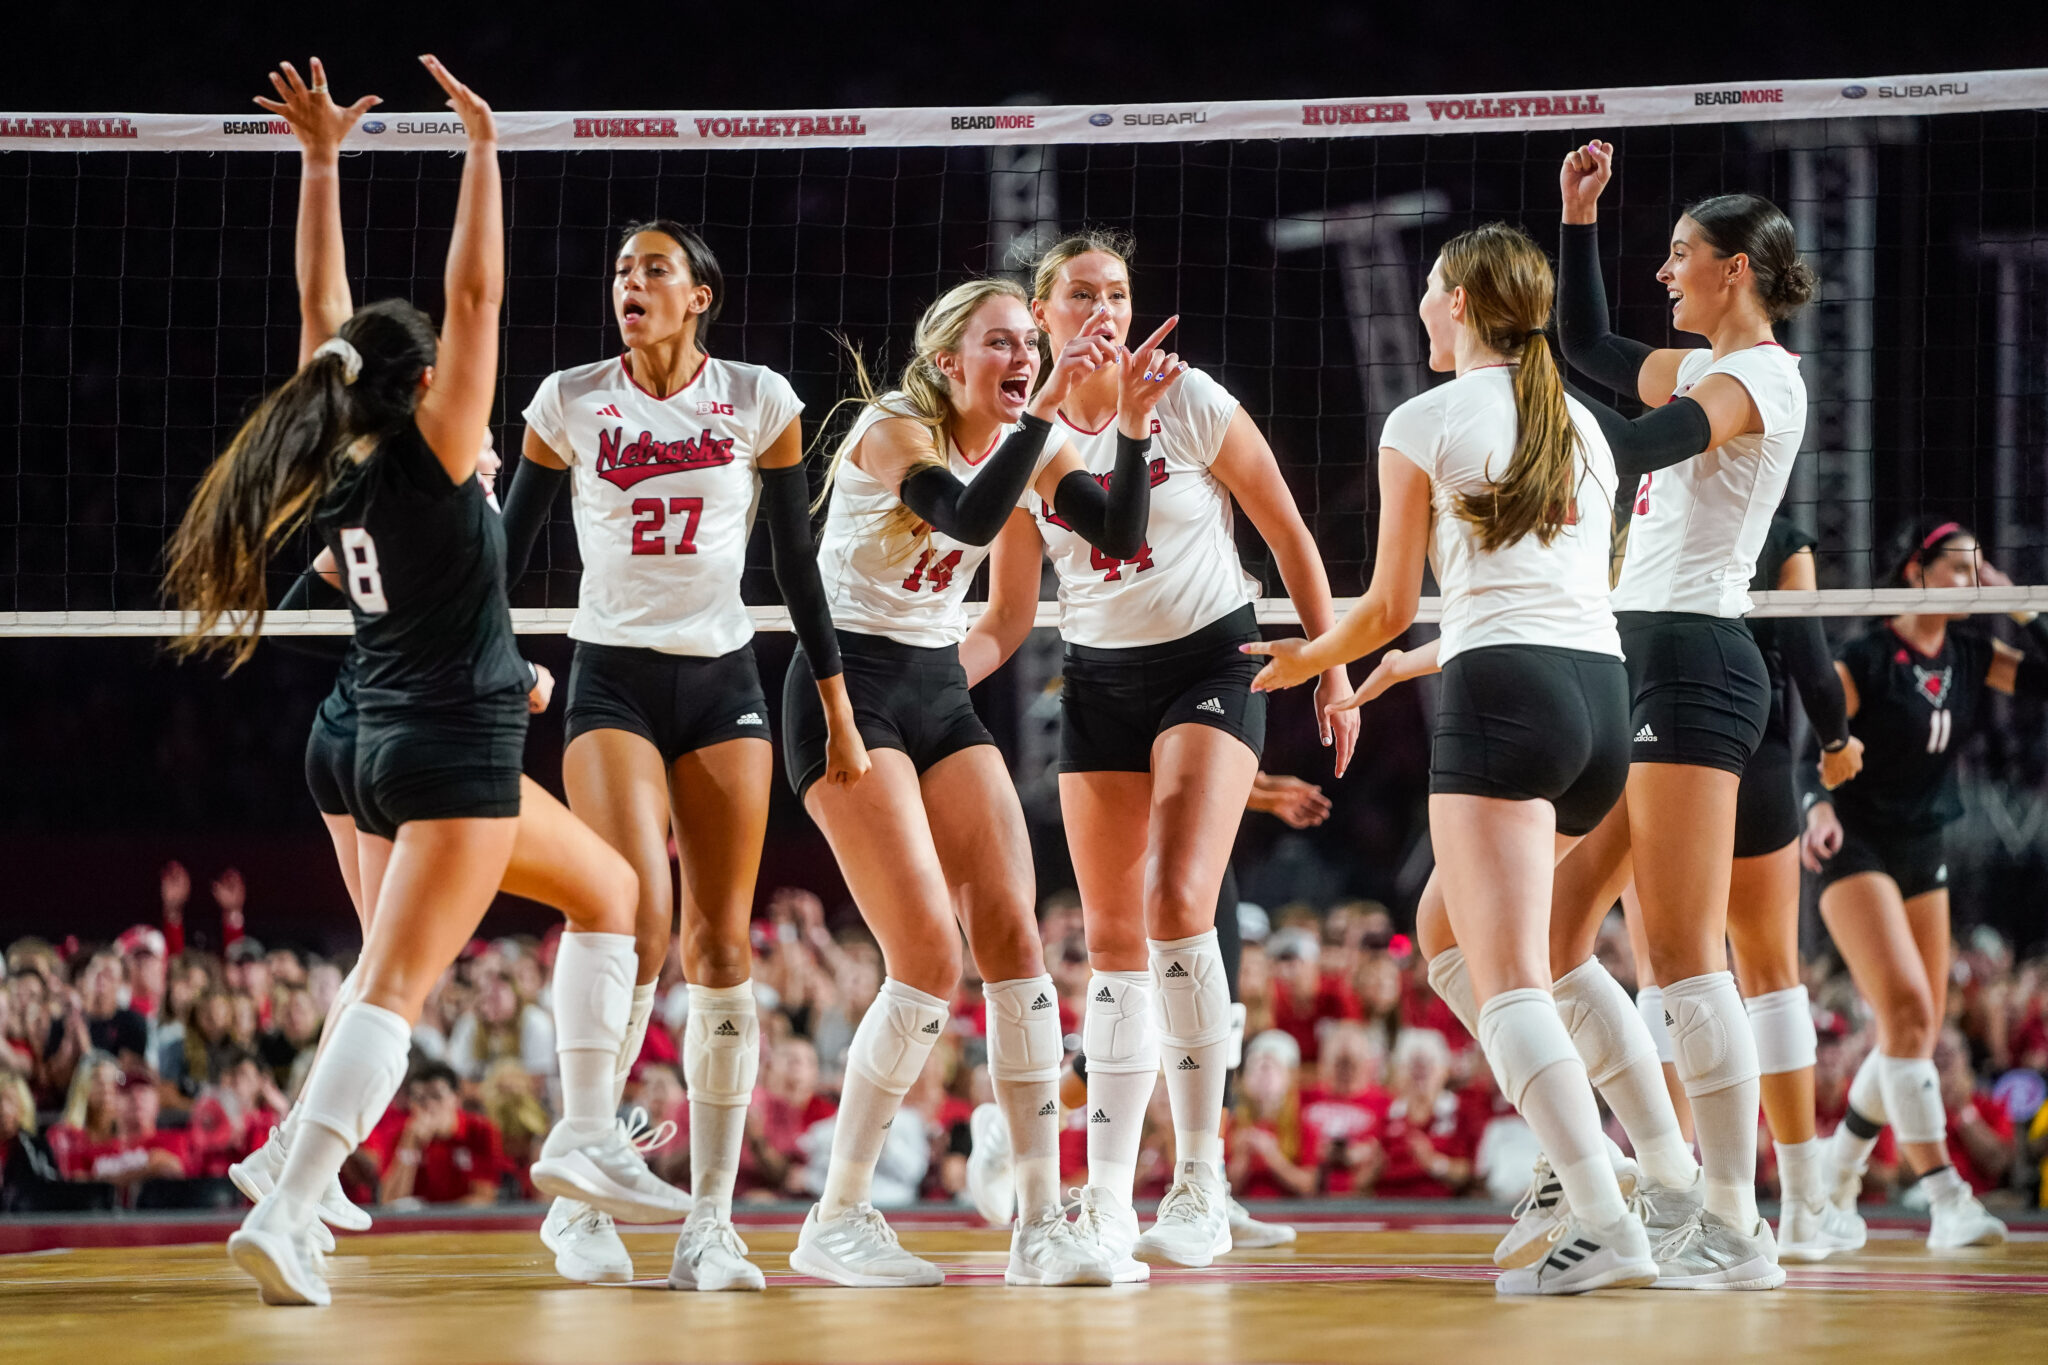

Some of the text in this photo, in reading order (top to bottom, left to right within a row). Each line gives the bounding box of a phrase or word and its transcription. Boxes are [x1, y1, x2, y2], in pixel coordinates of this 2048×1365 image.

[1694, 89, 1783, 106] BEARDMORE
[1878, 83, 1969, 98] SUBARU
[1123, 111, 1207, 126] SUBARU
[1302, 95, 1605, 125] HUSKER VOLLEYBALL
[0, 118, 138, 138] LLEYBALL
[223, 121, 294, 134] BEARDMO
[396, 122, 466, 134] SUBAR
[574, 115, 866, 138] HUSKER VOLLEYBALL
[951, 115, 1035, 130] BEARDMORE
[596, 426, 736, 476] Nebraska
[631, 497, 704, 555] 27
[340, 528, 390, 614] 8
[902, 548, 964, 593] 14
[1926, 709, 1952, 754] 11
